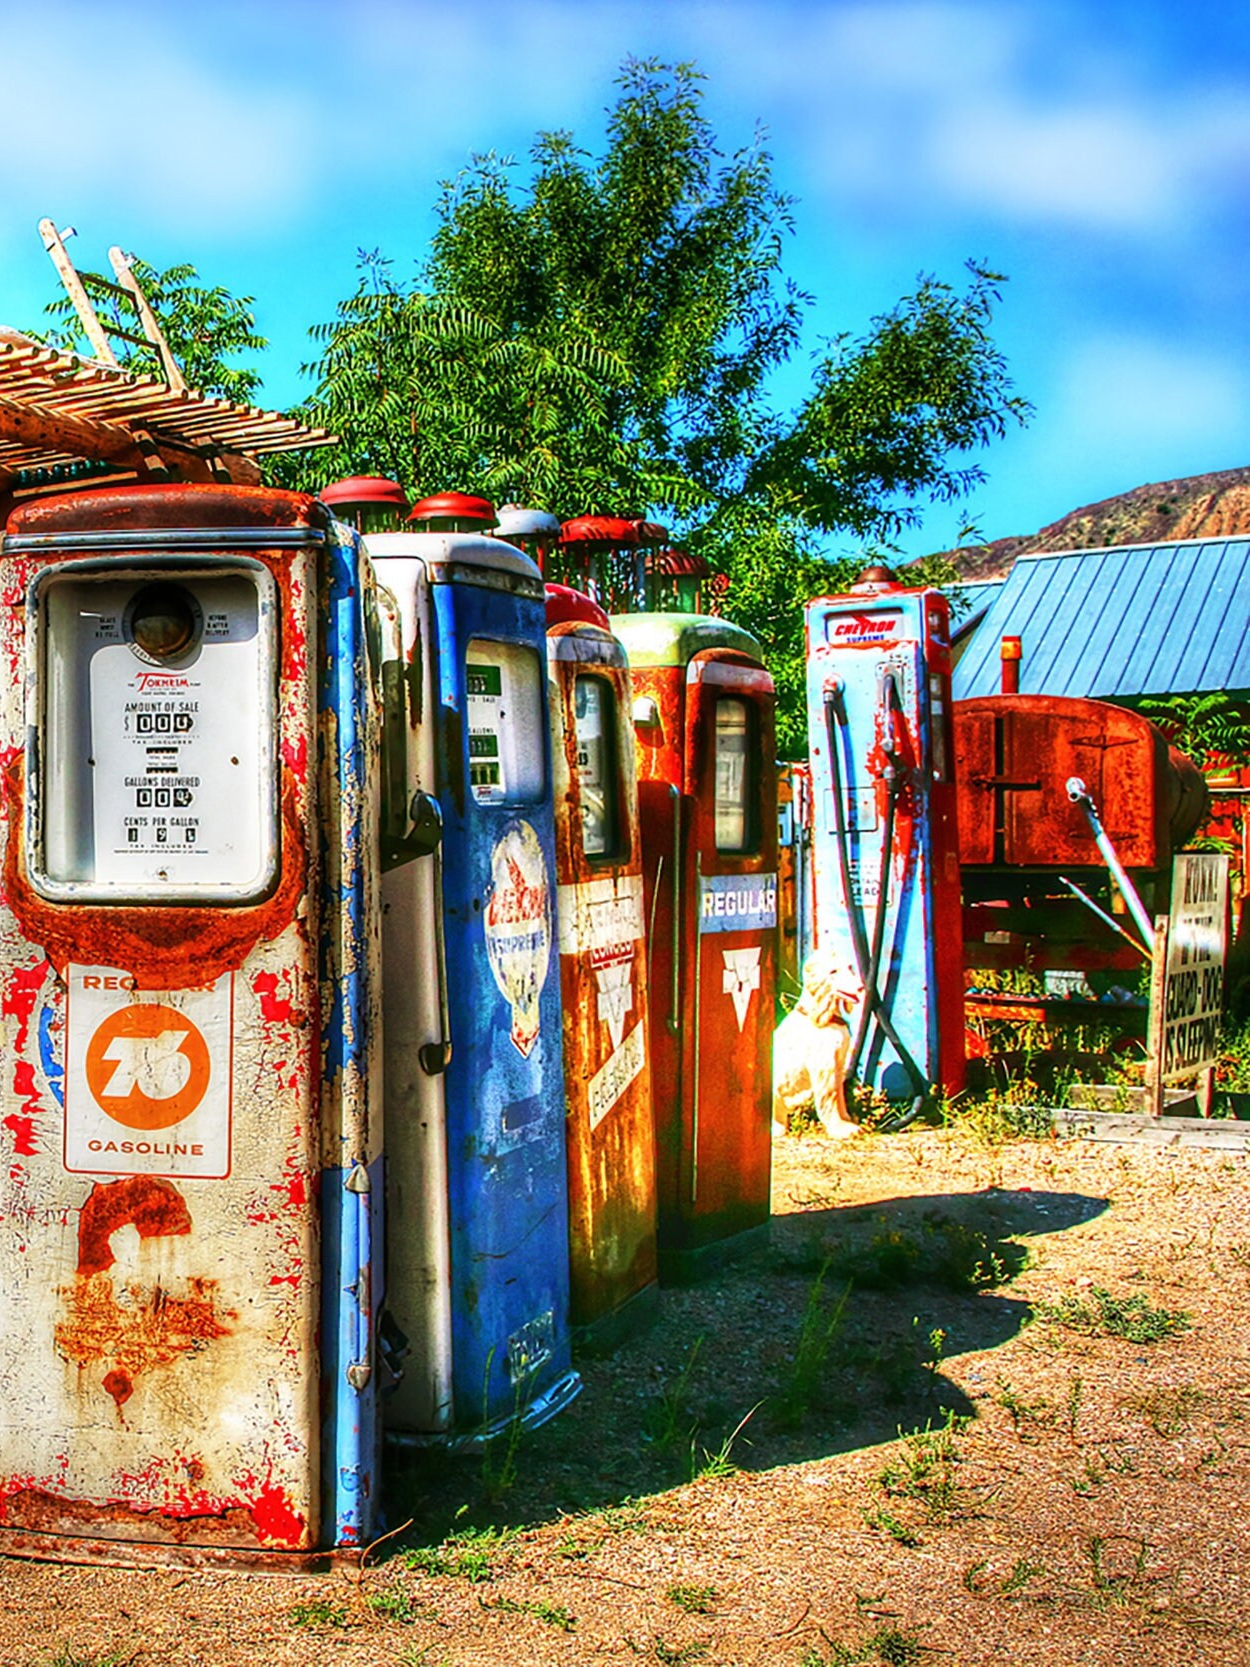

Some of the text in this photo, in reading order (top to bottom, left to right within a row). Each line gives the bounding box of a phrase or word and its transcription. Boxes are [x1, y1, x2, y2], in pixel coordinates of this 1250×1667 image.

[835, 615, 896, 636] CHEVRON
[125, 702, 199, 712] AMOUNT OF SALE
[124, 777, 200, 787] GALLONS DELIVERED
[124, 817, 199, 826] CENTS PER GALLON
[702, 890, 776, 917] REGULAR
[101, 1031, 191, 1100] 76
[88, 1140, 204, 1155] GASOLINE
